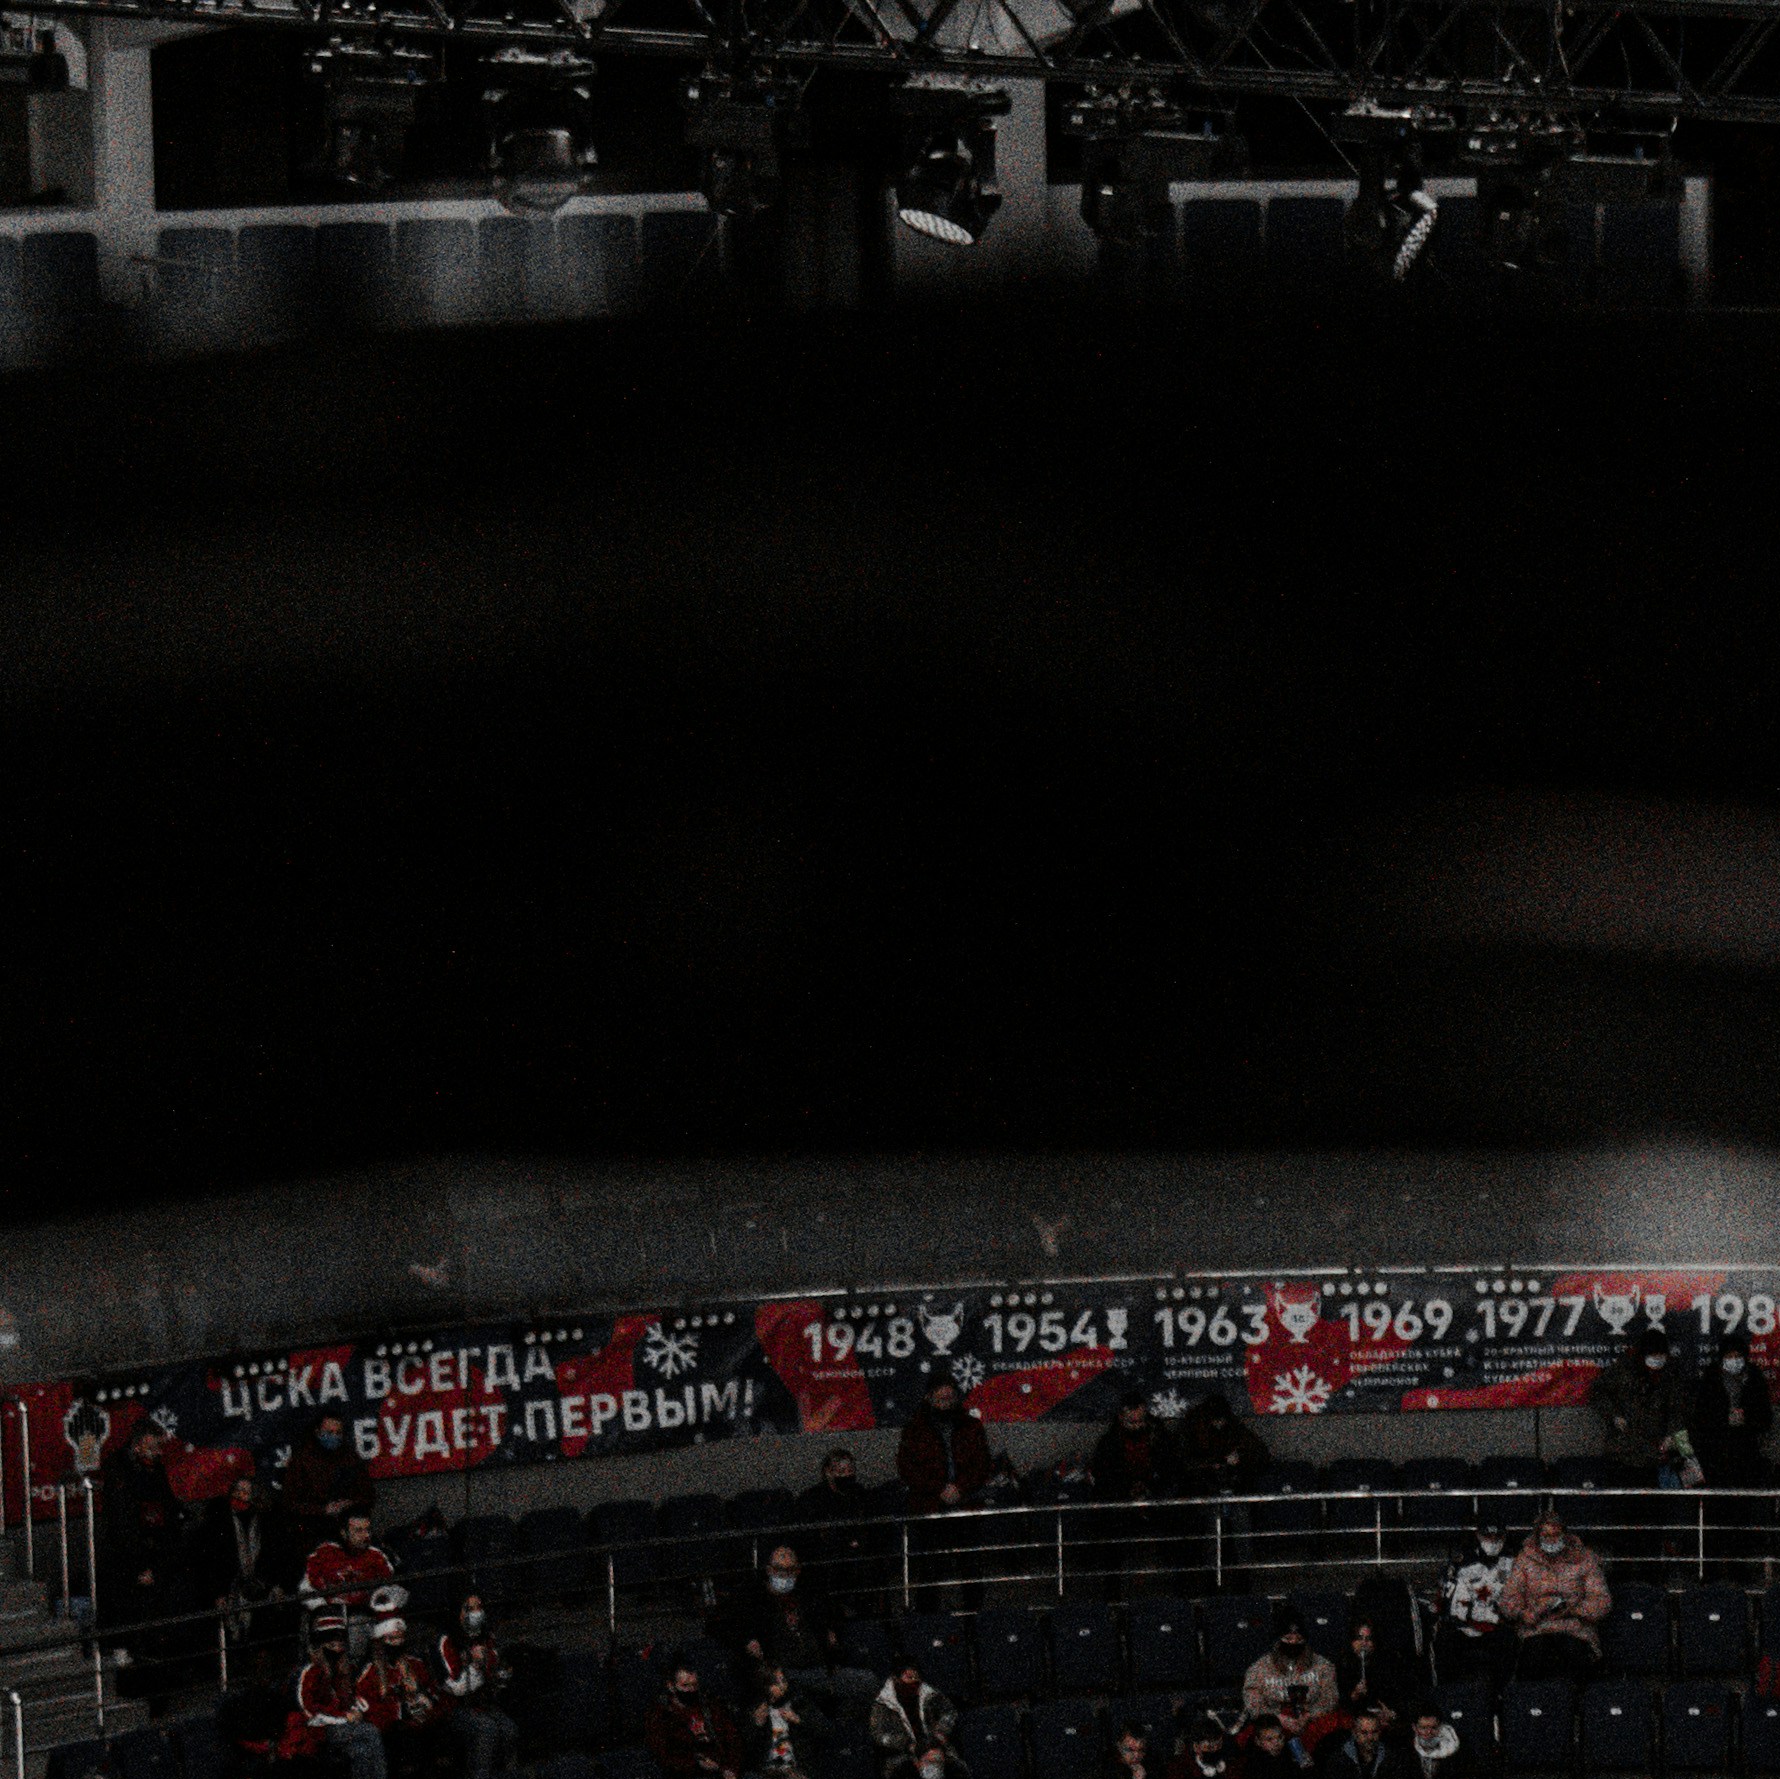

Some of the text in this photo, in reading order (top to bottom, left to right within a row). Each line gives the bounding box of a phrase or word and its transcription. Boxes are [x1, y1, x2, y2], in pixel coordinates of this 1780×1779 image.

[802, 1317, 916, 1362] 1948
[983, 1308, 1099, 1353] 1954
[1153, 1304, 1271, 1348] 1963
[1340, 1300, 1453, 1342] 1969
[1476, 1295, 1586, 1339] 1977
[220, 1343, 556, 1421] ЦСКА ВСЕГДА
[352, 1377, 756, 1462] БУДЕТ ПЕРВЫМ!
